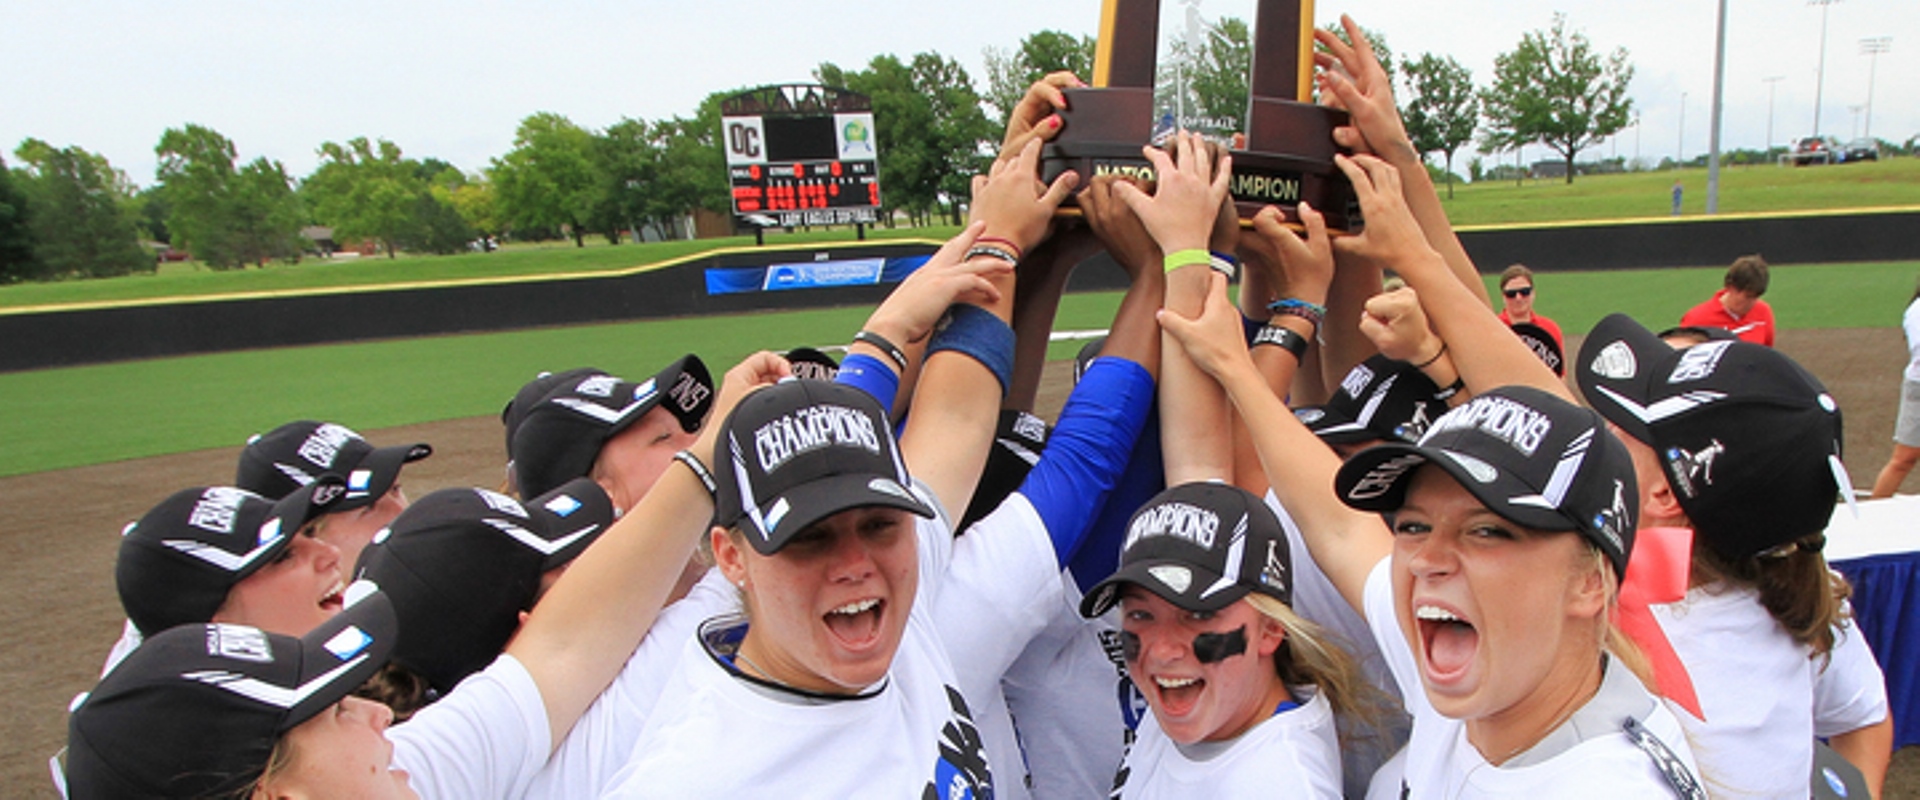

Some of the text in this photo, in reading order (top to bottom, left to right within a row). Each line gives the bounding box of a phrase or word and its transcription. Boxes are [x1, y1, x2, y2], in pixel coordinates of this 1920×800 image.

[729, 122, 760, 157] OC
[1230, 174, 1300, 200] AMPION
[754, 407, 880, 474] CHAMPIONS
